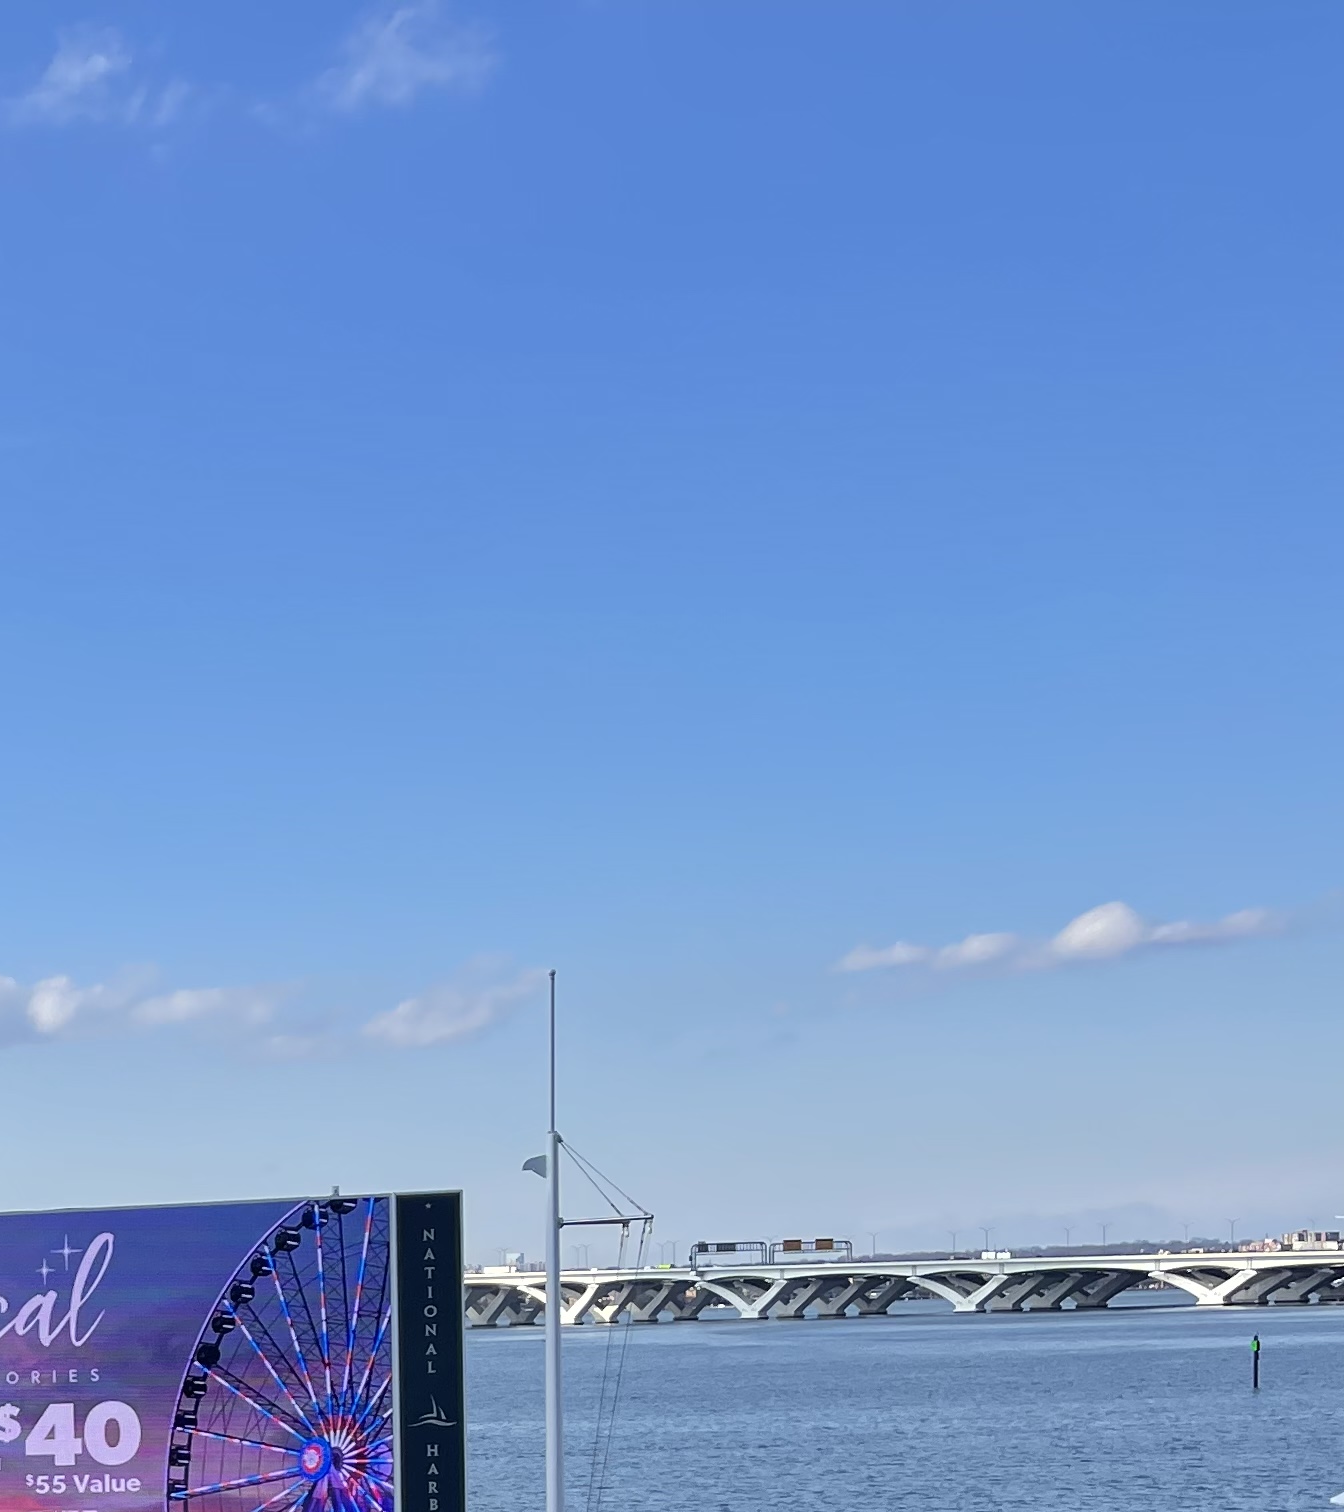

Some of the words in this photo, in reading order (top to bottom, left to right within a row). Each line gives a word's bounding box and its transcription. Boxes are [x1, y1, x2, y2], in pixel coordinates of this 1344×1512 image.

[422, 1228, 438, 1374] NATIONAL
[25, 1474, 67, 1495] $55
[72, 1473, 142, 1494] Value
